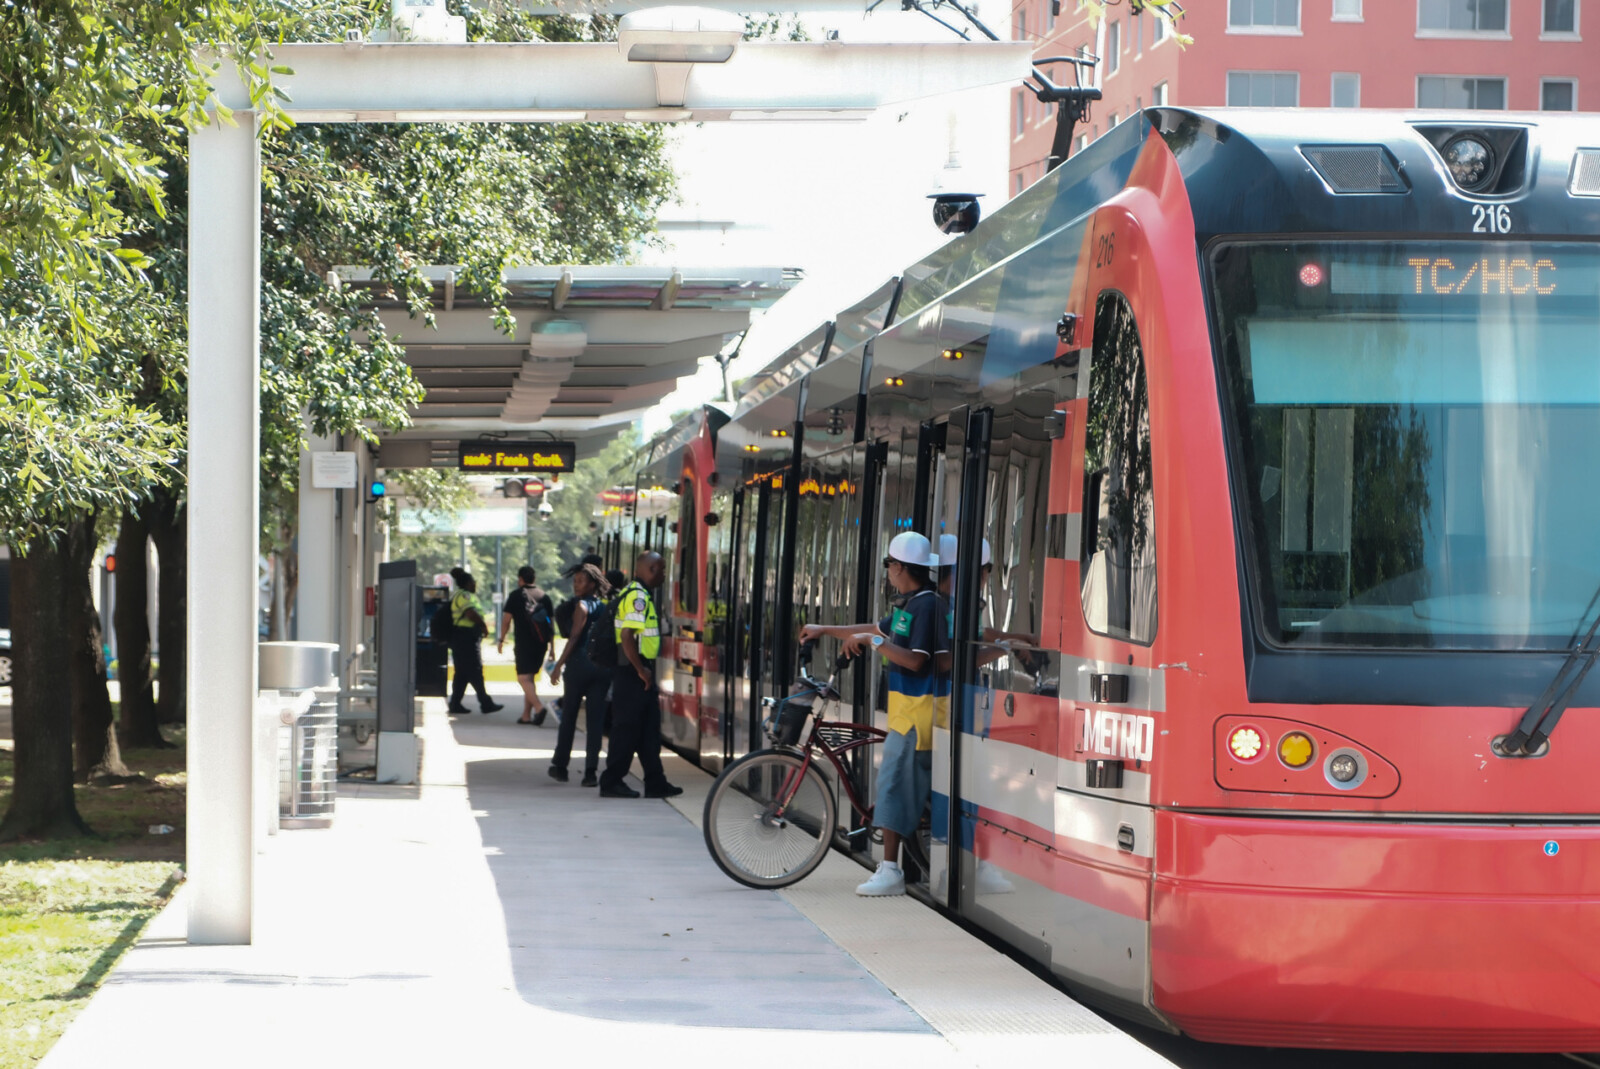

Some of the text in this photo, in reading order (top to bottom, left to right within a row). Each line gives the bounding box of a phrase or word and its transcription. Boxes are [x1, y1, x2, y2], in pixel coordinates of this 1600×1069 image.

[1471, 203, 1512, 234] 216
[1096, 231, 1115, 269] 216
[1408, 258, 1557, 294] TC/HCC
[1083, 708, 1155, 762] METRO
